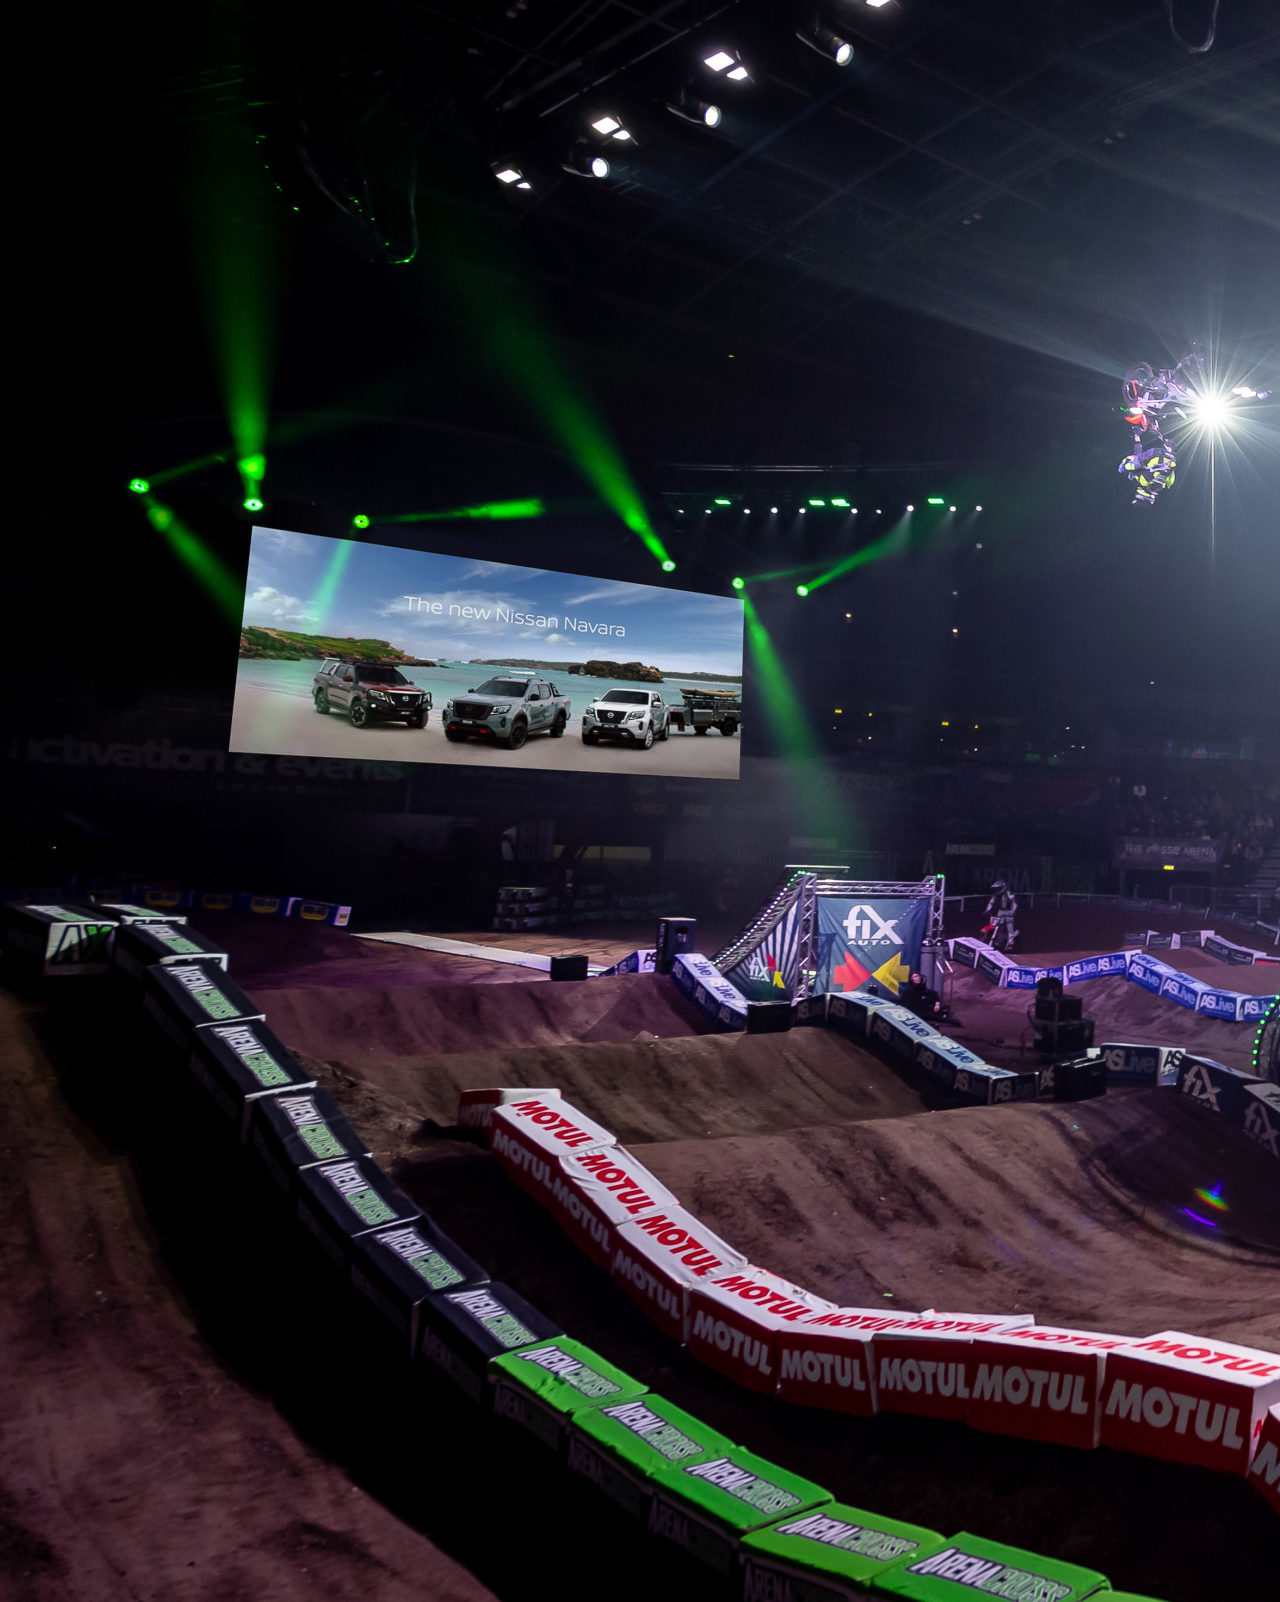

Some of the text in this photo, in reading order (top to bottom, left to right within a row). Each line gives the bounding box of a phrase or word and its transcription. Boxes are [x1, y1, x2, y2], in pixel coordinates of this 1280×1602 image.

[404, 595, 627, 637] The new Nissan Navara
[28, 732, 226, 774] ctivation
[1183, 846, 1216, 857] ARENA
[842, 904, 905, 945] fix
[1068, 962, 1098, 980] ASLive
[1098, 956, 1127, 973] ASLive
[1129, 962, 1160, 987] ASLive
[1163, 979, 1197, 1006] ASLive
[1200, 993, 1236, 1014] ASLive
[1102, 1048, 1156, 1073] ASLive
[458, 1103, 497, 1128] MOTU
[511, 1100, 595, 1148] MOTUL
[493, 1128, 553, 1190] MOTUL
[576, 1154, 656, 1215] MOTUL
[552, 1178, 611, 1253] MOTUL
[635, 1214, 724, 1277] MOTUL
[614, 1249, 682, 1321] MOTUL
[711, 1275, 813, 1322] MOTUL
[693, 1310, 774, 1376] MOTUL
[999, 1330, 1131, 1350] MOTUL
[514, 1345, 623, 1399] ARENACROSS
[781, 1348, 867, 1391] MOTUL
[879, 1356, 970, 1400] MOTUL
[972, 1363, 1090, 1416] MOTUL
[600, 1401, 705, 1462] ARENACROSS
[1104, 1379, 1245, 1451] MOTUL
[683, 1457, 802, 1516] ARENACROSS
[647, 1491, 733, 1577] ARENA
[773, 1513, 919, 1562] ARENACROSS
[905, 1547, 1074, 1602] ARENACROSS
